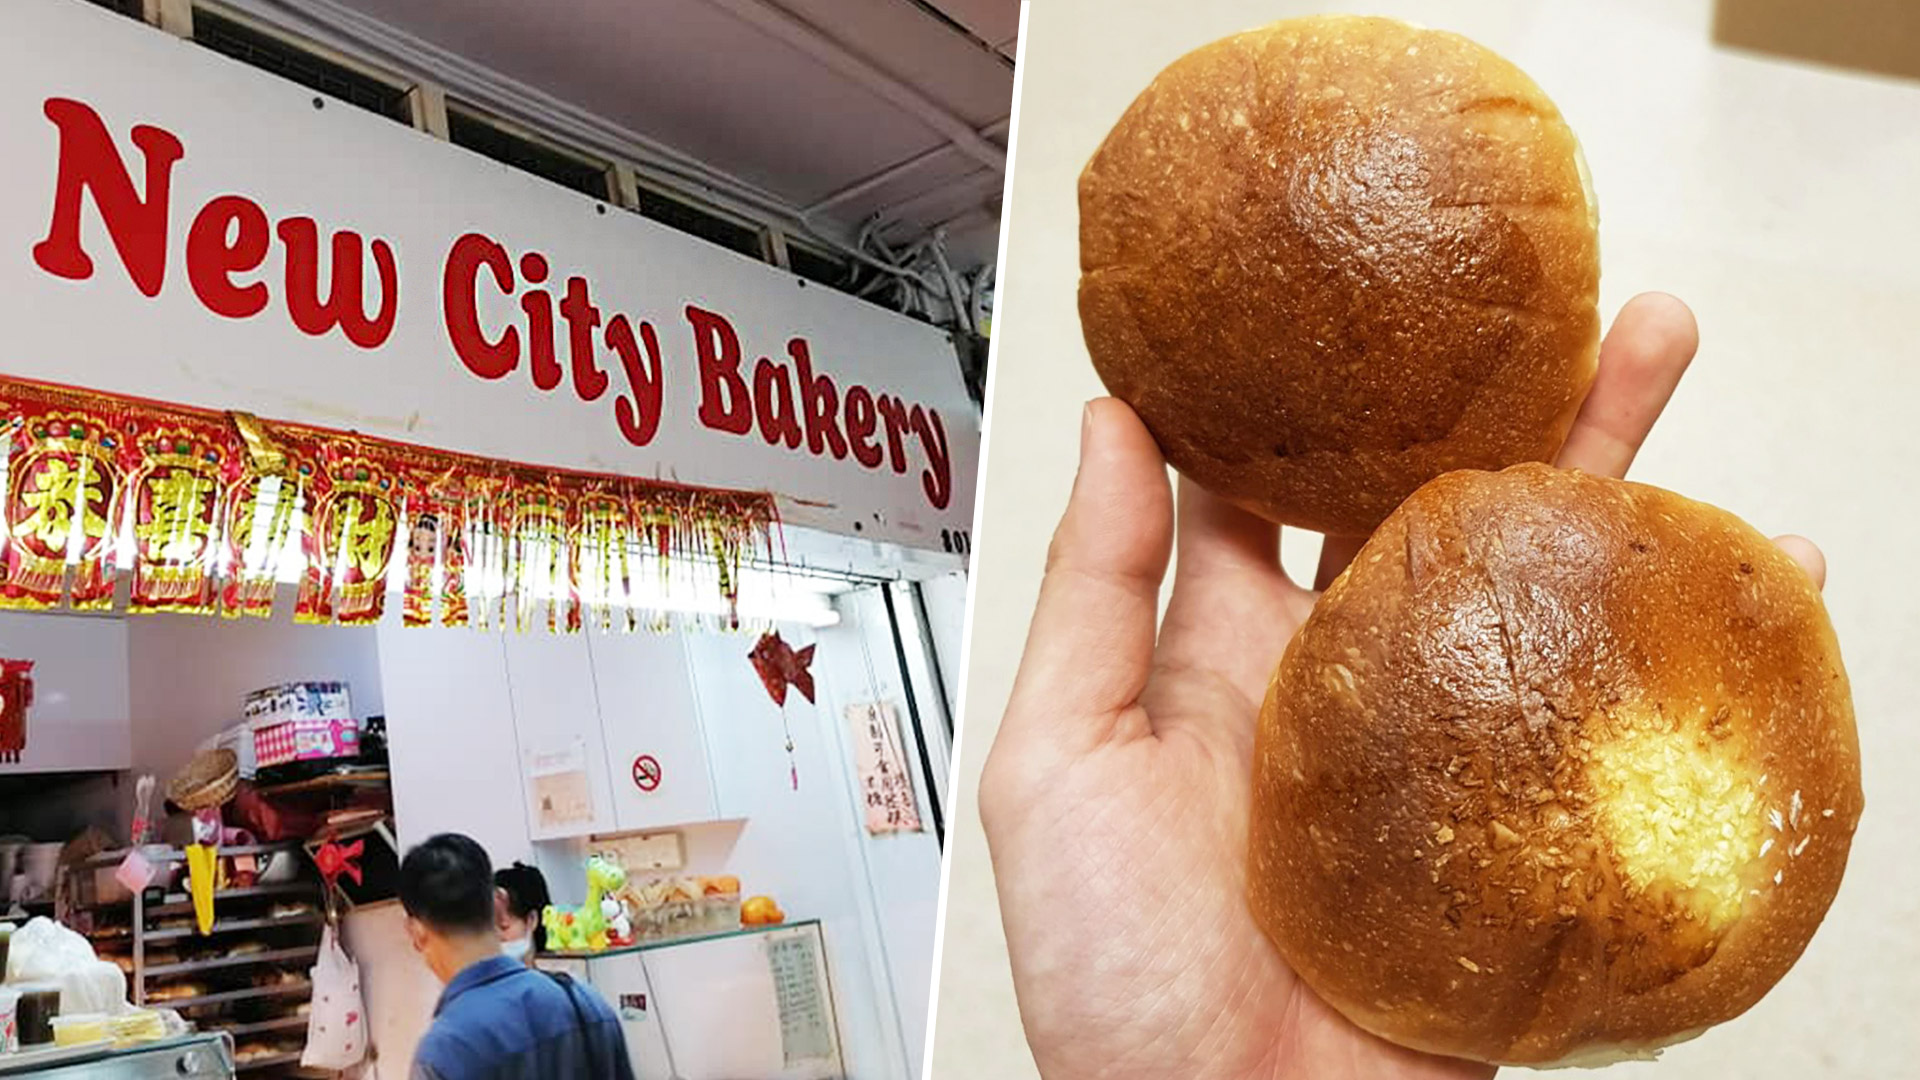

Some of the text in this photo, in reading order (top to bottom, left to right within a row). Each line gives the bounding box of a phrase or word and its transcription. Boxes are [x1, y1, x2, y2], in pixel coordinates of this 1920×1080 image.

[31, 96, 951, 510] New City Bakery
